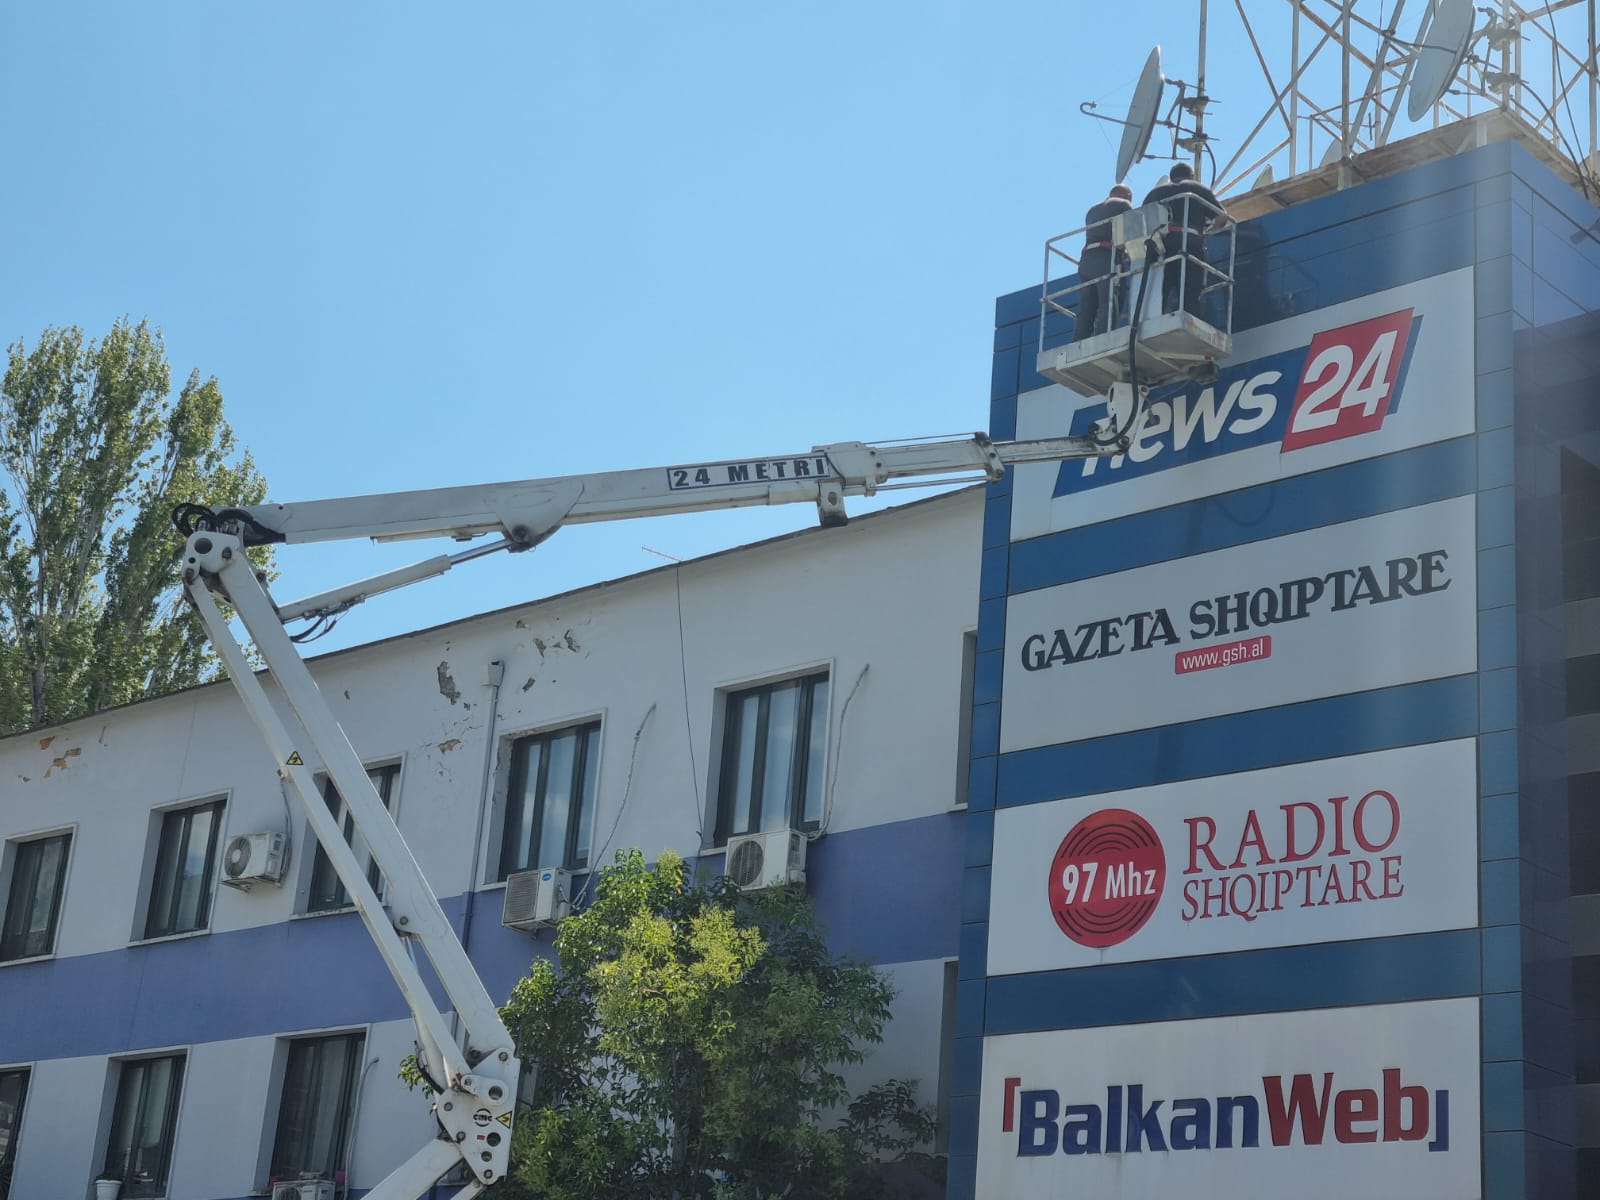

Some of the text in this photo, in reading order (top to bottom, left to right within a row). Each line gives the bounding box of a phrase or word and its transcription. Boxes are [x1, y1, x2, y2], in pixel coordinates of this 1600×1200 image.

[1291, 331, 1399, 434] 24
[673, 458, 825, 487] 24 METRI
[1021, 549, 1452, 672] GAZETA SHQIPTARE
[1181, 637, 1264, 670] www.gsh.al
[1182, 789, 1401, 875] RADIO
[1062, 861, 1157, 905] 97 Mhz
[1181, 856, 1405, 922] SHQIPTARE
